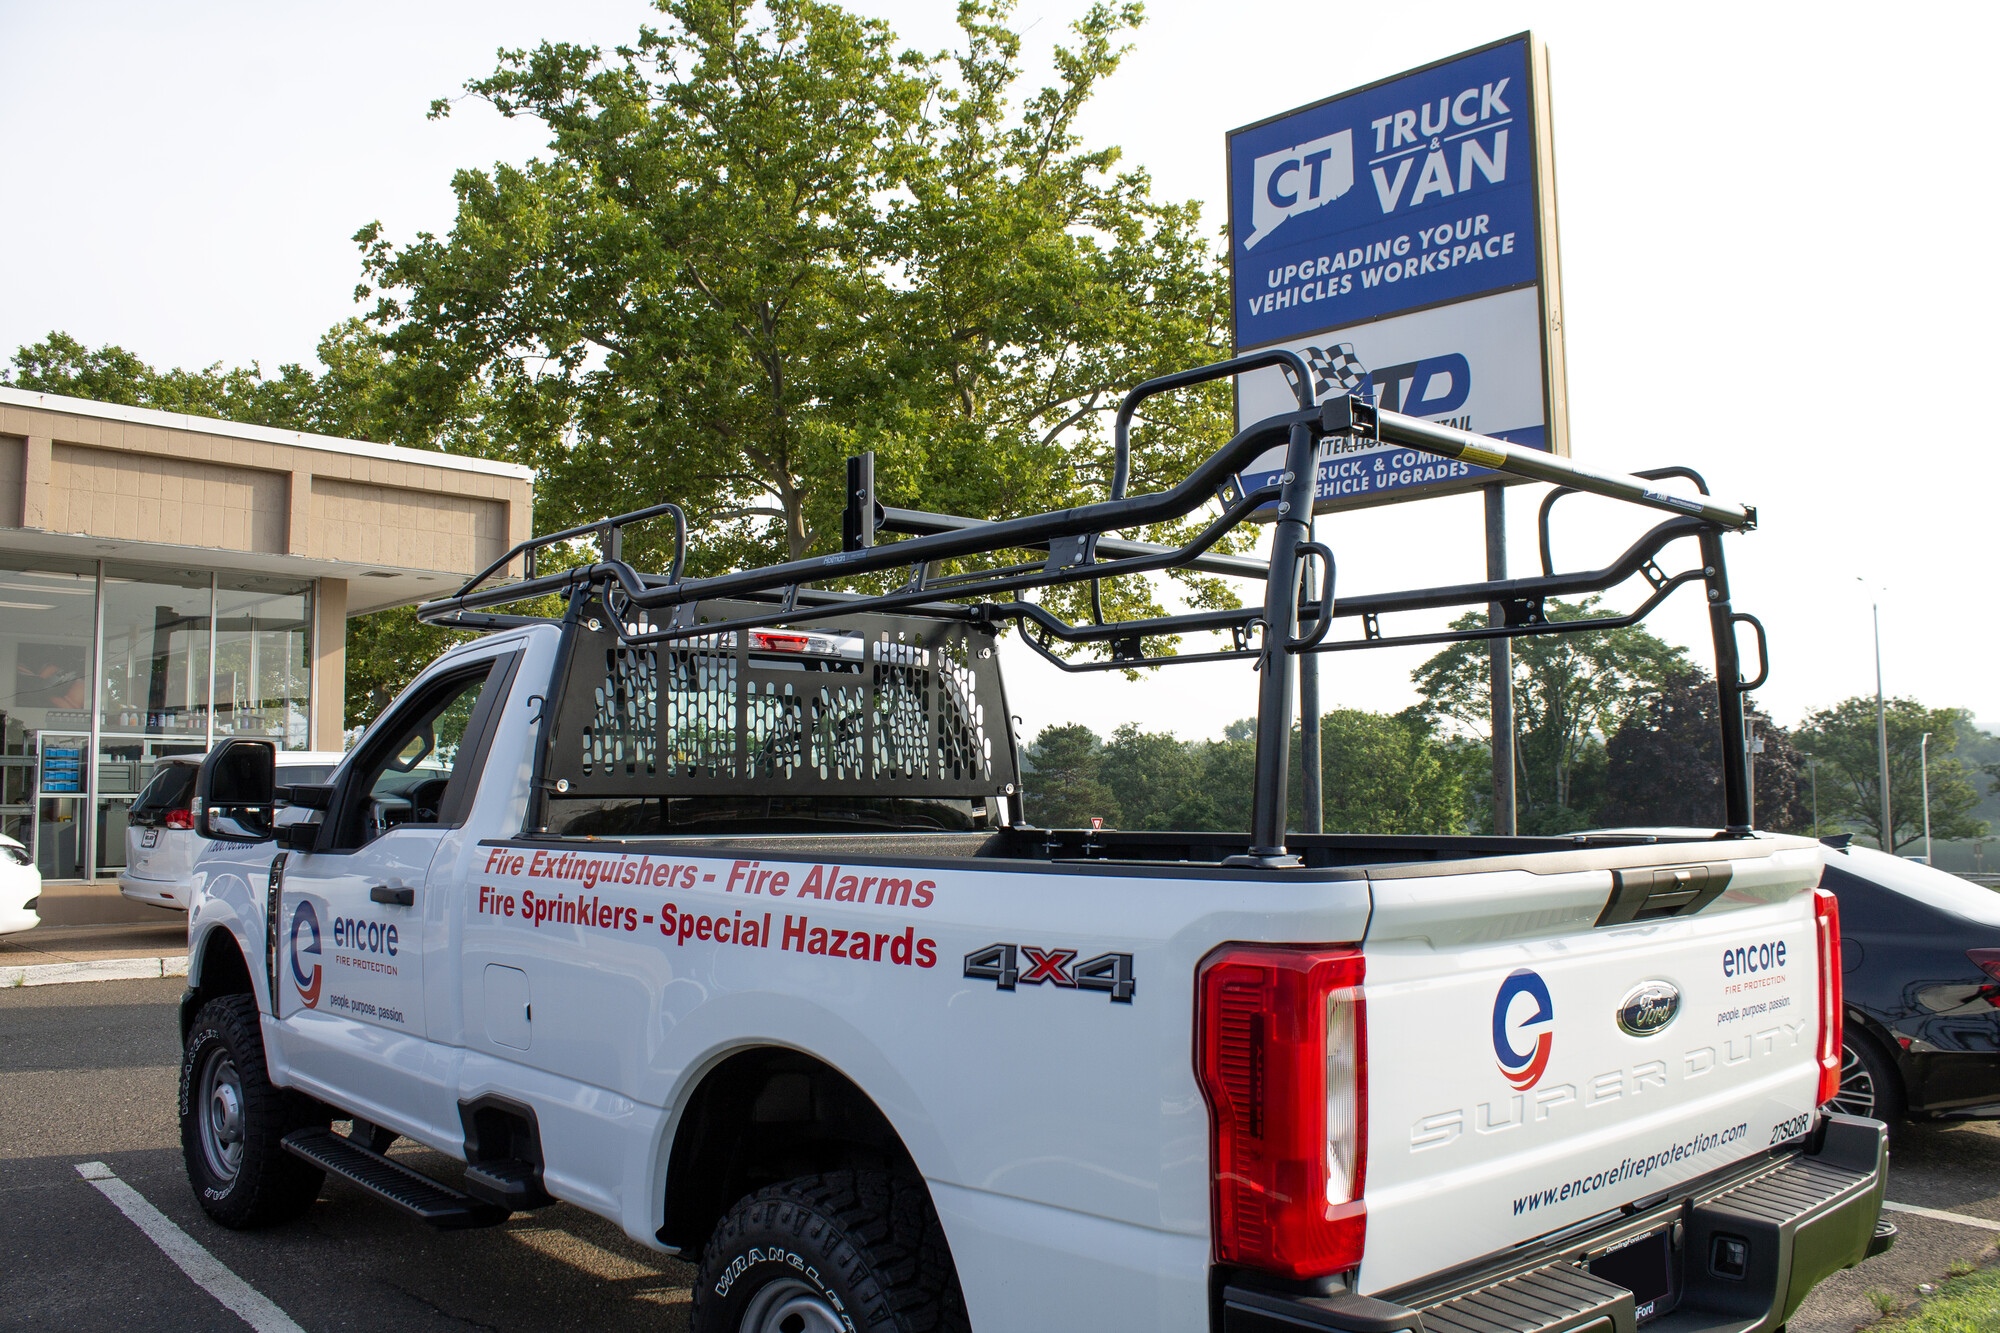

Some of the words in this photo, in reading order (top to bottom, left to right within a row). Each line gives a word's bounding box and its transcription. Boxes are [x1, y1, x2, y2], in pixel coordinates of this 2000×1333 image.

[1371, 77, 1511, 153] TRUCK
[1429, 137, 1441, 150] &
[1267, 147, 1332, 209] CT
[1371, 129, 1508, 214] VAN
[1267, 235, 1410, 288] UPGRADING
[1419, 214, 1490, 249] YOUR
[1249, 275, 1352, 316] VEHICLES
[1361, 233, 1515, 288] WORKSPACE
[1315, 476, 1370, 498] EHICLE
[1376, 462, 1469, 489] UPGRADES
[1318, 461, 1367, 481] RUCK,
[1373, 457, 1386, 472] &
[484, 848, 524, 876] Fire
[528, 850, 698, 890] Extinguishers
[725, 860, 790, 896] Fire
[797, 865, 937, 909] Alarms
[334, 916, 399, 957] encore
[478, 886, 515, 917] Fire
[521, 889, 638, 932] Sprinklers
[660, 903, 770, 949] Special
[782, 915, 938, 969] Hazards
[336, 955, 351, 966] FIRE
[353, 958, 398, 976] PROTECTION
[1723, 940, 1786, 977] encore
[1725, 984, 1741, 995] FIRE
[1744, 975, 1786, 991] PROTECTION
[330, 994, 350, 1010] people.
[351, 1000, 377, 1016] purpose.
[378, 1006, 404, 1023] passion.
[1636, 992, 1670, 1026] Ford
[1410, 1059, 1666, 1154] SUPER
[1684, 1019, 1806, 1080] DUTY
[1769, 1112, 1809, 1146] 27SQ8R
[1513, 1122, 1747, 1216] www.encorefireprotection.com
[1606, 1231, 1652, 1253] DowlingFord.com
[1635, 1301, 1654, 1320] Ford
